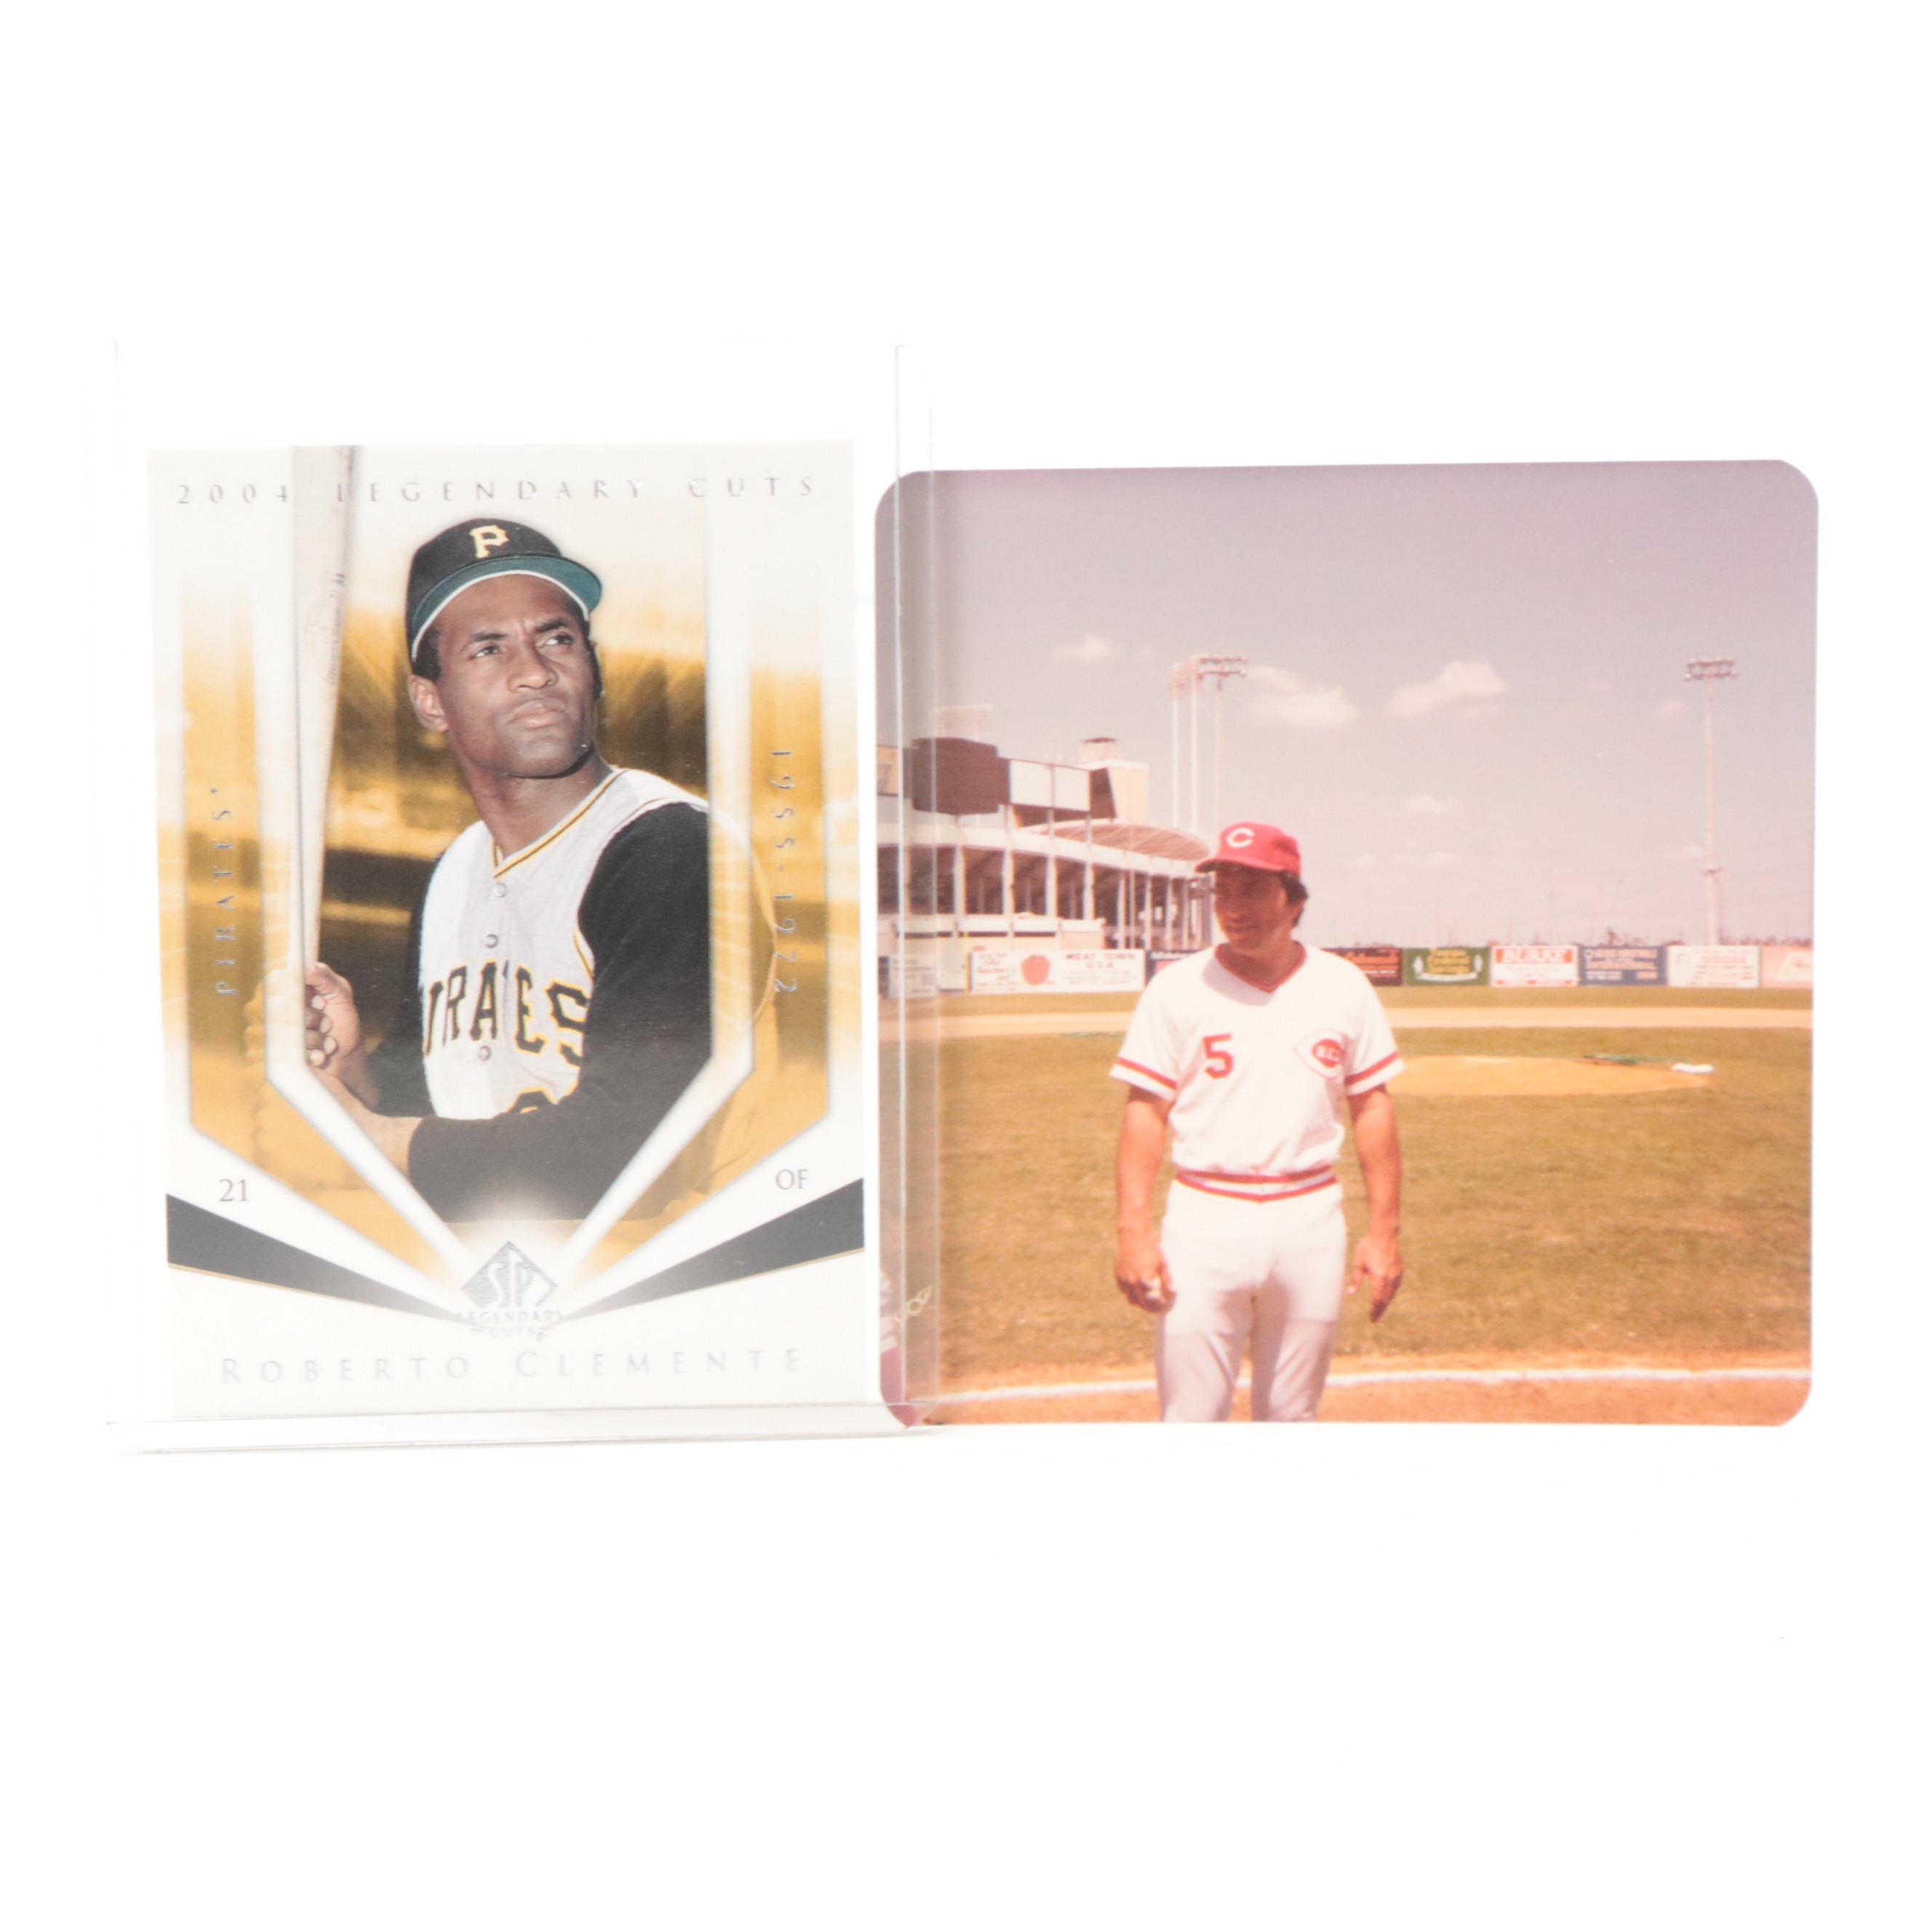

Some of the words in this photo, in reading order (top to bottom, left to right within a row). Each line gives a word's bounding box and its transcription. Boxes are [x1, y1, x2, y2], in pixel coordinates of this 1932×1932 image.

[176, 484, 289, 505] 2004
[337, 480, 644, 504] LEGENDARY
[688, 476, 813, 498] CUTS
[469, 524, 509, 558] P
[1226, 828, 1256, 847] C
[1202, 1033, 1234, 1079] 5
[219, 1178, 249, 1202] 21
[775, 1168, 809, 1190] OF
